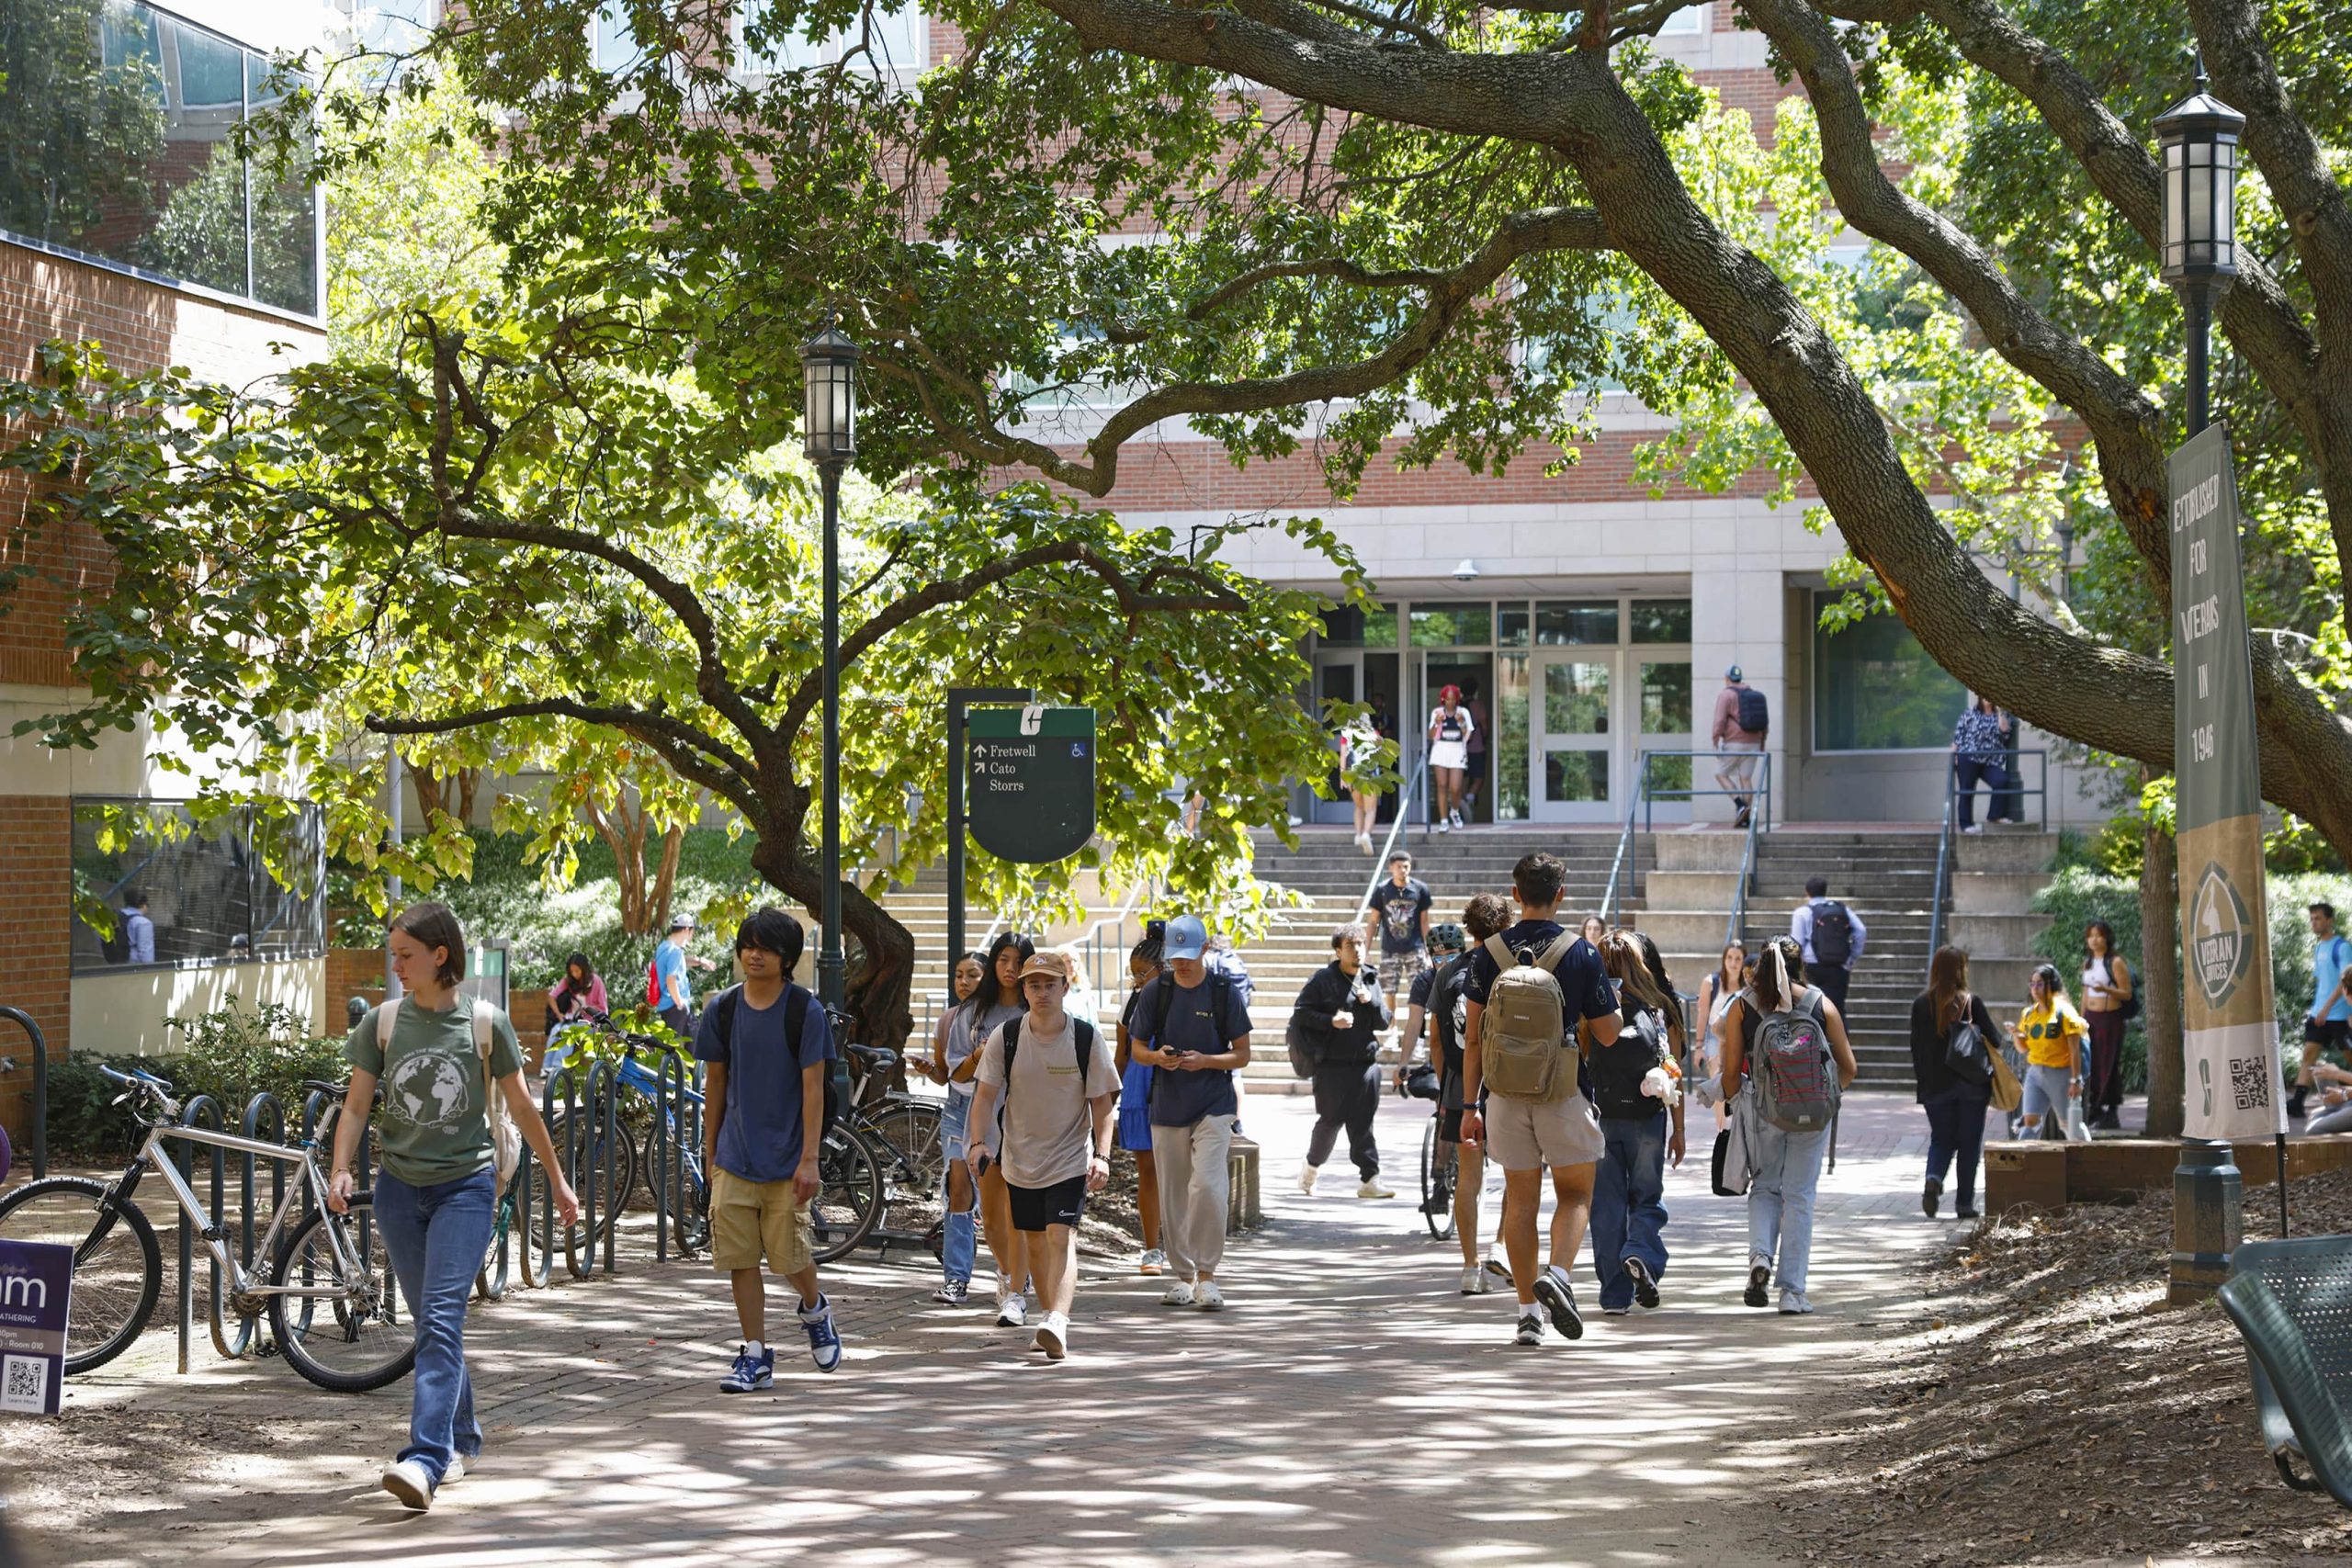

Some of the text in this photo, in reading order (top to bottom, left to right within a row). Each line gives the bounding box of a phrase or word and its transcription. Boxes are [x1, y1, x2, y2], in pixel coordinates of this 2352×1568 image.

[2175, 473, 2219, 533] ETBLISHED
[2190, 538, 2207, 578] FOR
[2180, 594, 2219, 644] VTERANS
[2198, 663, 2209, 699] IN
[990, 745, 1036, 758] Fretwell
[2192, 723, 2214, 762] 1946
[989, 762, 1016, 774] Cato
[989, 779, 1024, 791] Storrs
[2200, 935, 2233, 965] VTERAN
[0, 1276, 47, 1309] m
[8, 1339, 30, 1349] Room
[31, 1341, 44, 1350] 010
